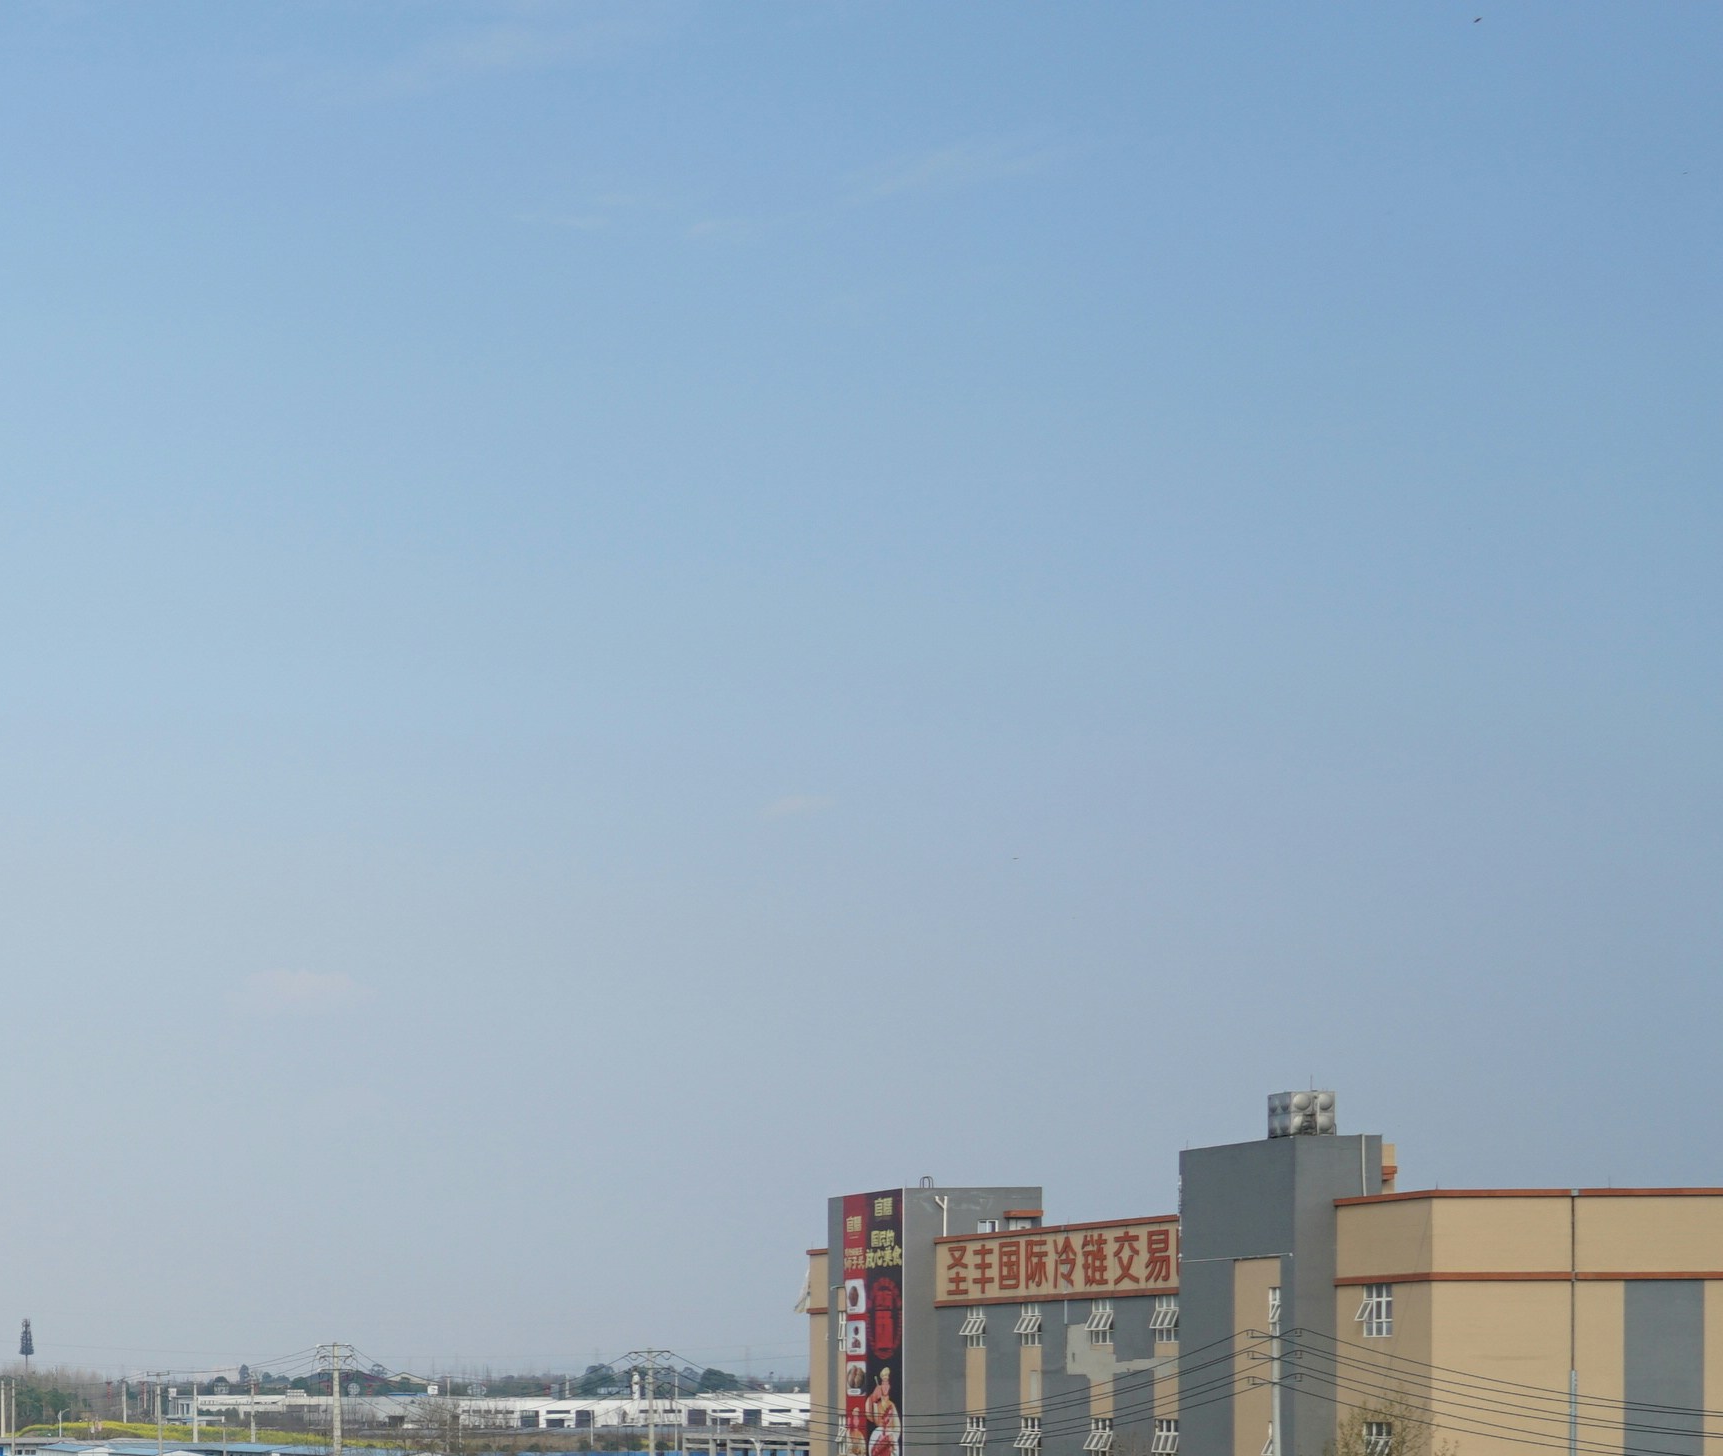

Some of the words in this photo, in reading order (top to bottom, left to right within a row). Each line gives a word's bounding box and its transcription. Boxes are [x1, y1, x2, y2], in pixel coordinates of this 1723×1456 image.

[865, 1245, 902, 1269] 放心美食
[947, 1228, 1180, 1296] 圣丰国际冷链交易
